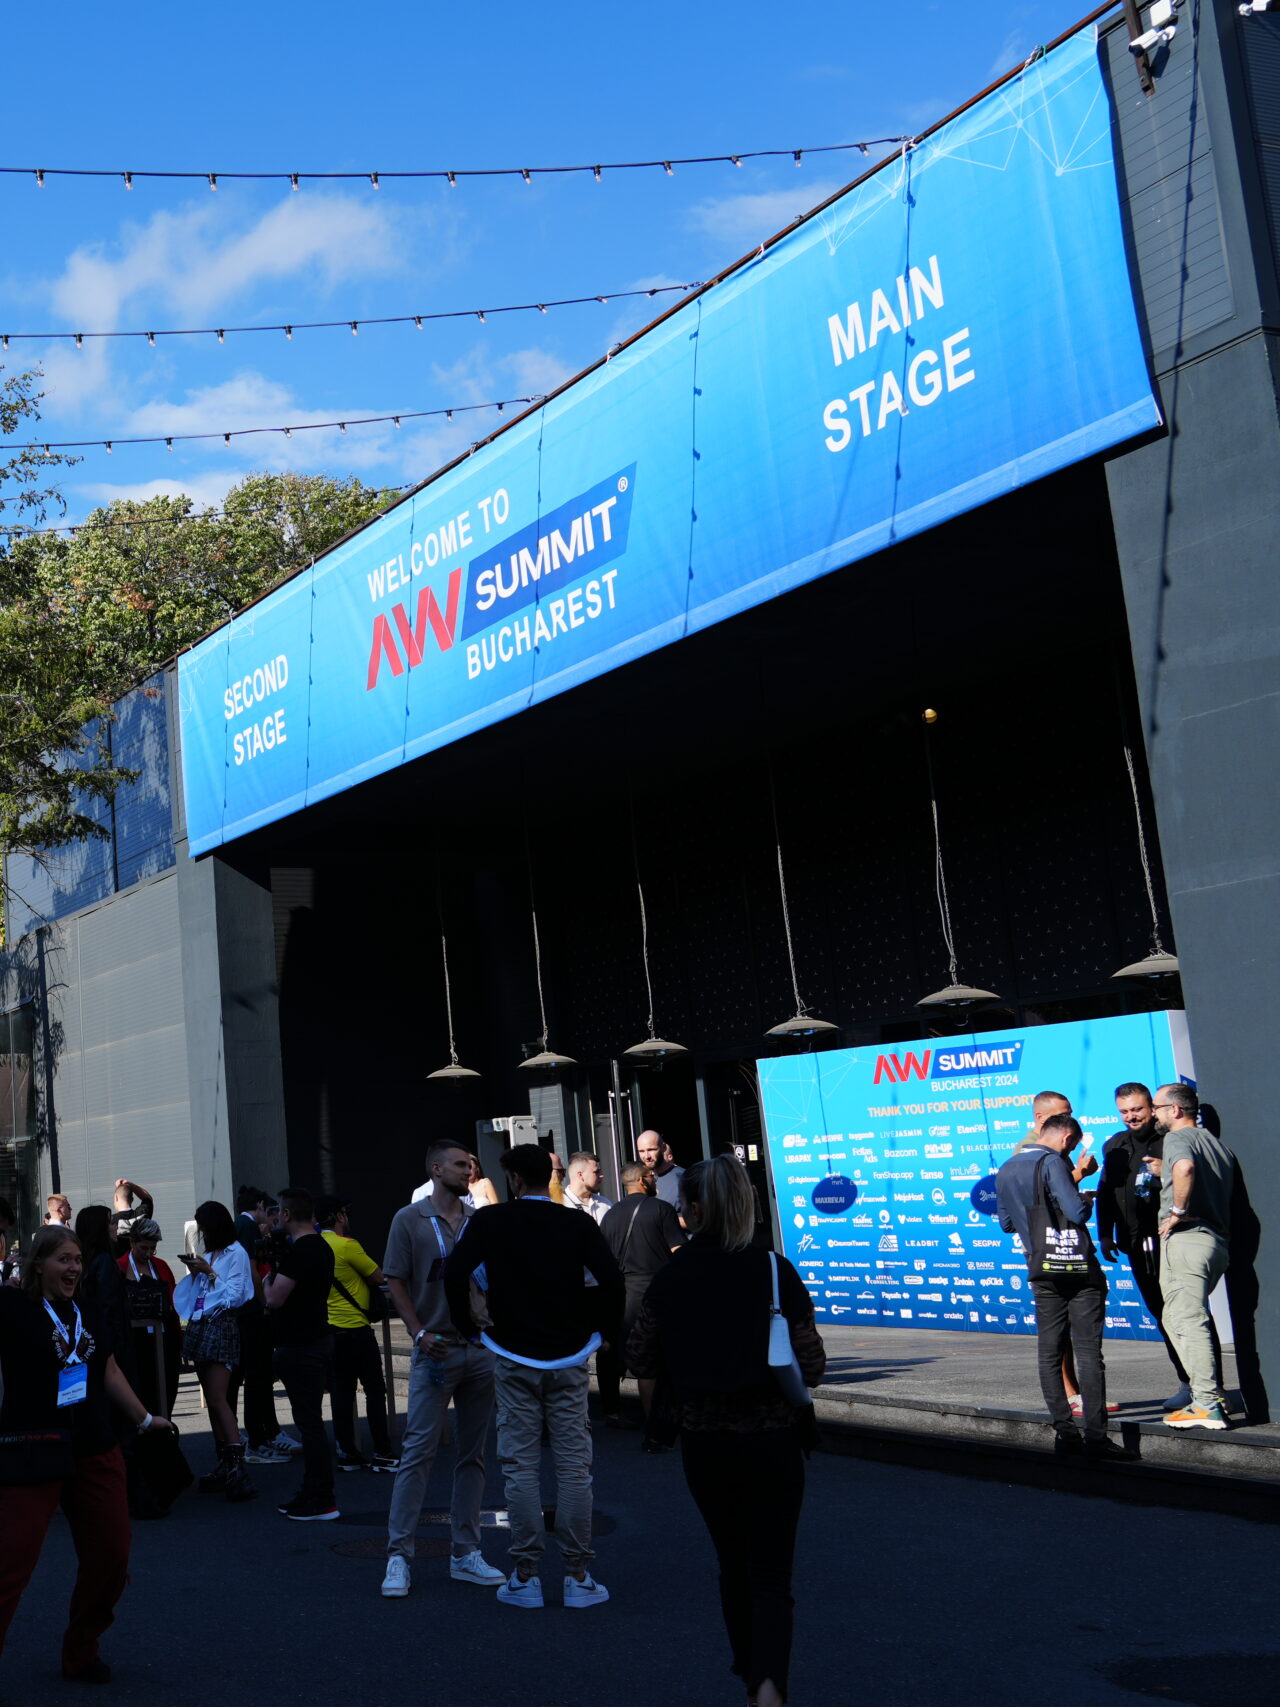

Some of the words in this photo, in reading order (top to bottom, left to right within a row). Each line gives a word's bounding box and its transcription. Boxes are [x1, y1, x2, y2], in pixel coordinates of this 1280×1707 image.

[828, 255, 945, 367] MAIN
[822, 327, 975, 454] STAGE
[367, 510, 473, 603] WELCOME
[477, 487, 509, 535] TO
[474, 495, 618, 612] SUMMIT
[467, 568, 620, 681] BUCHAREST
[224, 653, 289, 721] SECOND
[233, 709, 287, 766] STAGE
[938, 1048, 1016, 1071] SUMMIT
[930, 1076, 993, 1092] BUCHAREST
[995, 1074, 1020, 1087] 2024
[867, 1105, 902, 1118] THANK
[904, 1102, 925, 1115] YOU
[927, 1101, 949, 1112] FOR
[950, 1098, 981, 1111] YOUR
[983, 1094, 1036, 1109] SUPPORT
[880, 1129, 923, 1139] LIVEJASMIN
[966, 1142, 1019, 1152] BLACKCATCAR
[972, 1240, 1002, 1248] SEGPAY
[1045, 1237, 1079, 1247] MONEY
[1046, 1227, 1079, 1240] MAKE
[1045, 1253, 1085, 1261] PROBLEMS
[1055, 1246, 1074, 1254] NOT
